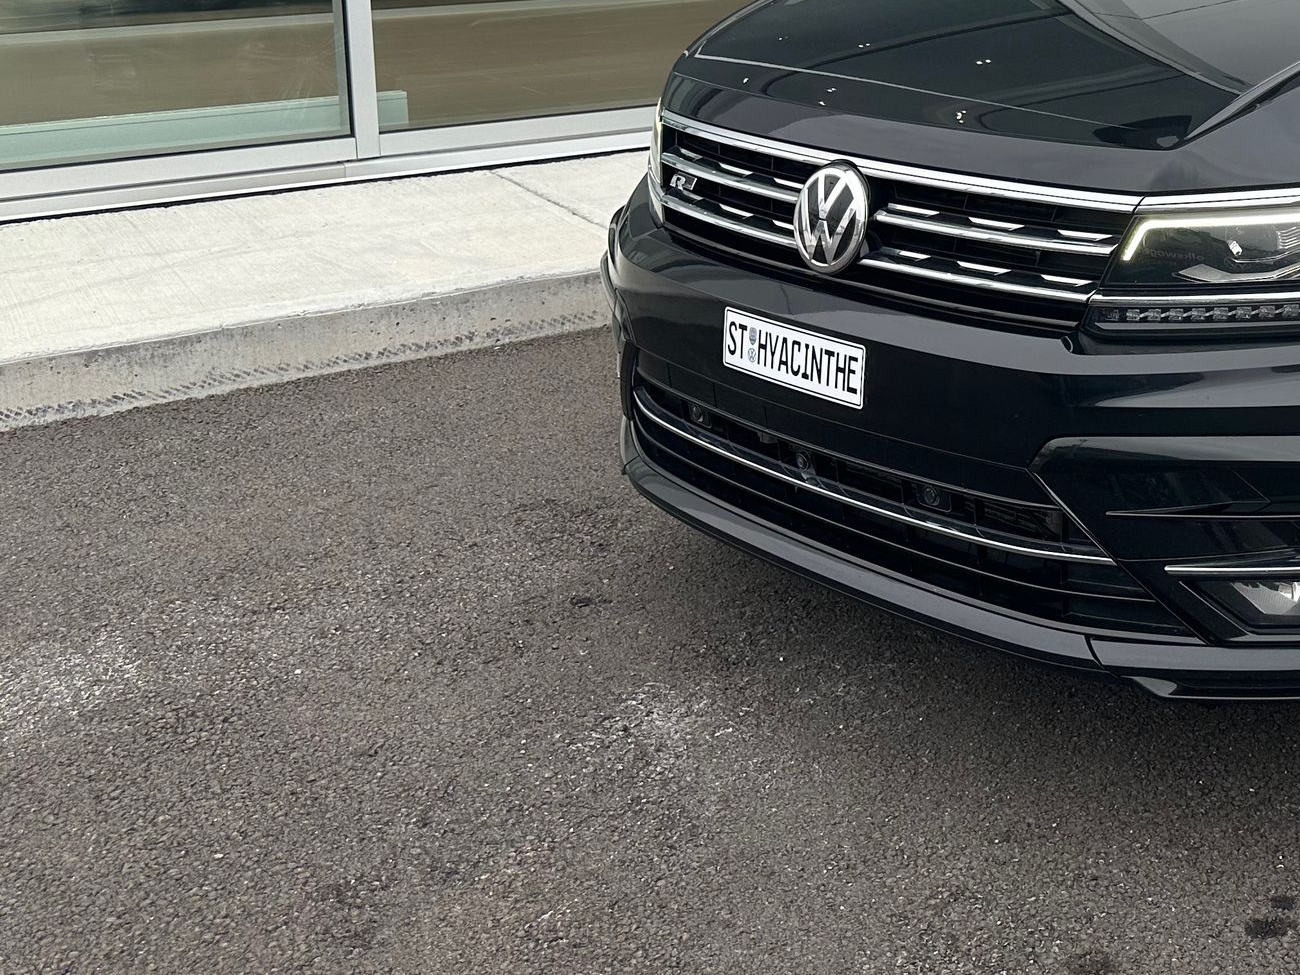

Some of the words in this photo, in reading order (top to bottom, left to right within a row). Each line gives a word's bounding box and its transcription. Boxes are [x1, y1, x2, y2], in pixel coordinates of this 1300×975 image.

[670, 173, 687, 193] R
[794, 166, 868, 273] VW
[727, 321, 747, 360] ST
[757, 329, 859, 395] HYACINTHE
